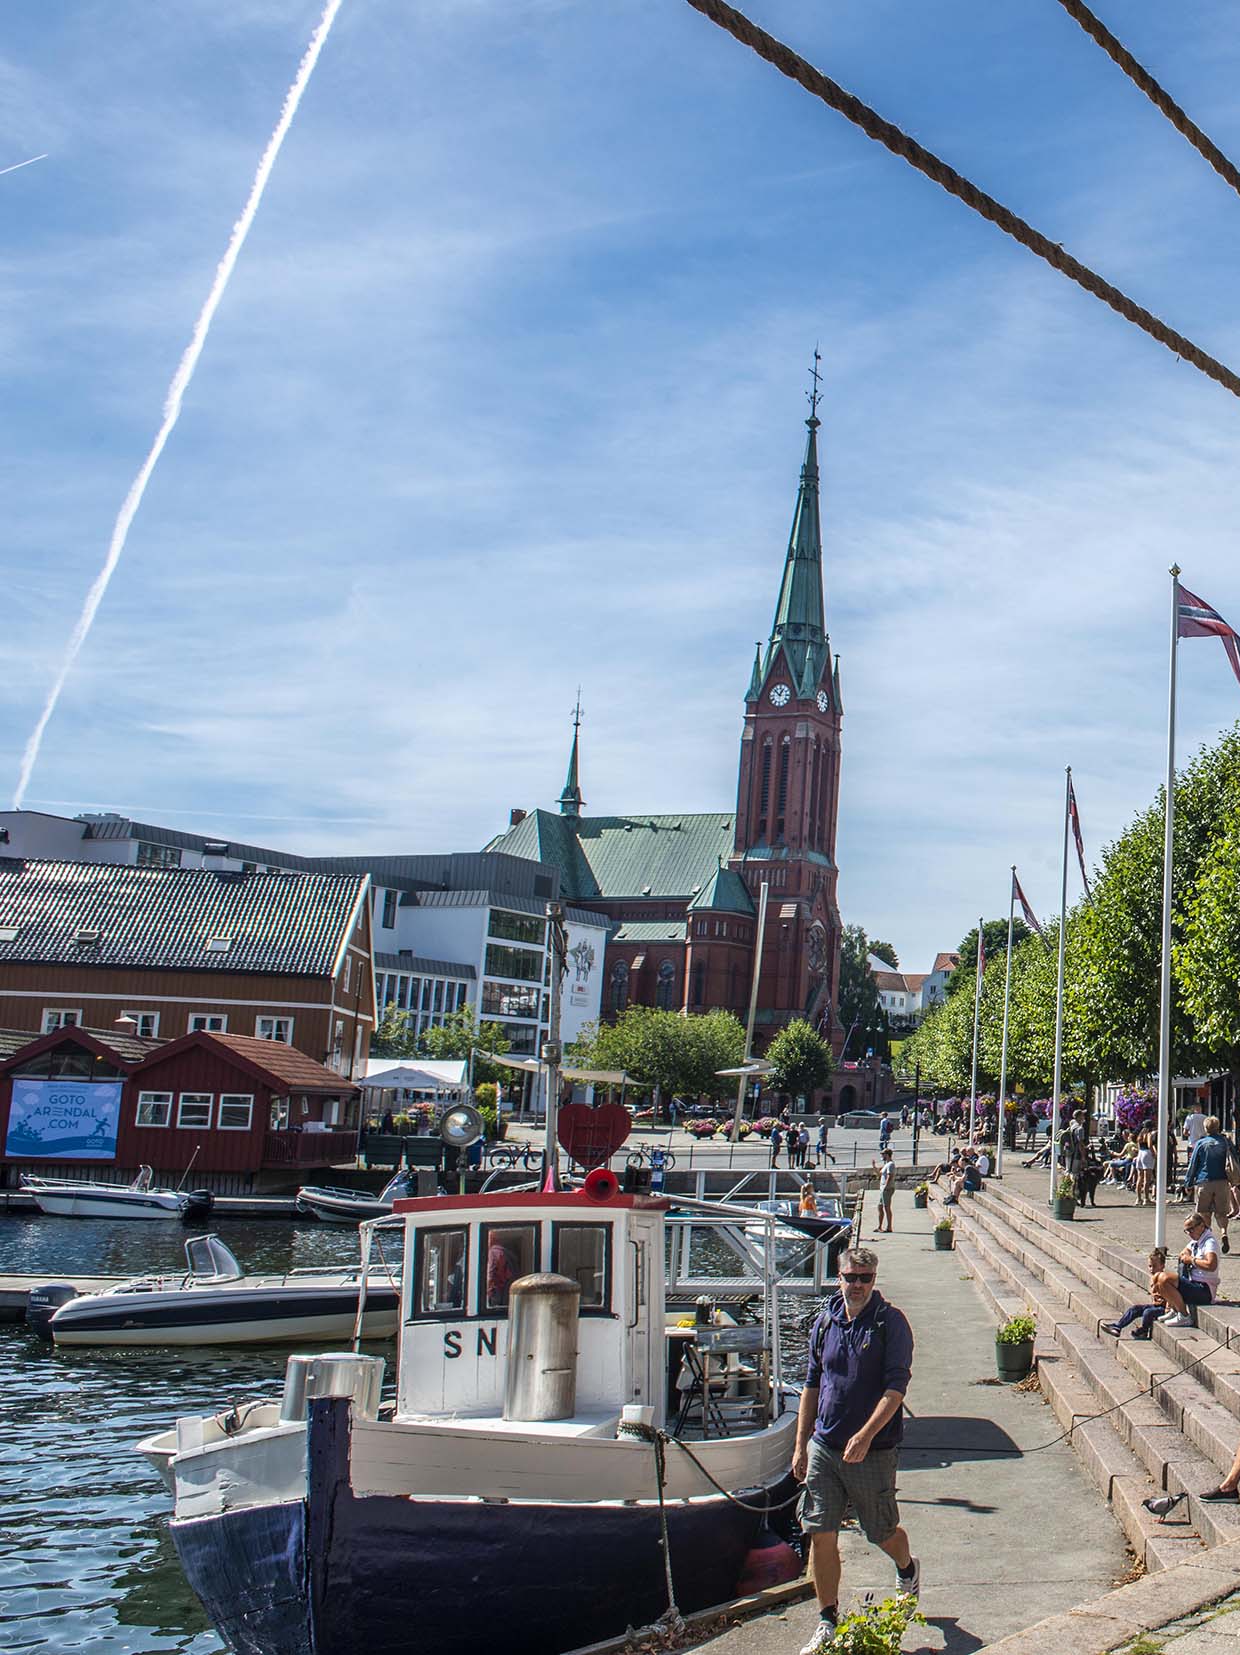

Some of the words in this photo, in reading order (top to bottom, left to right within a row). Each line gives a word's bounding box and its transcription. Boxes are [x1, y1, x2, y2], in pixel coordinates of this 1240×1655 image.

[49, 1095, 85, 1104] GOTO
[34, 1106, 96, 1117] ARENDAL
[48, 1119, 79, 1128] .COM
